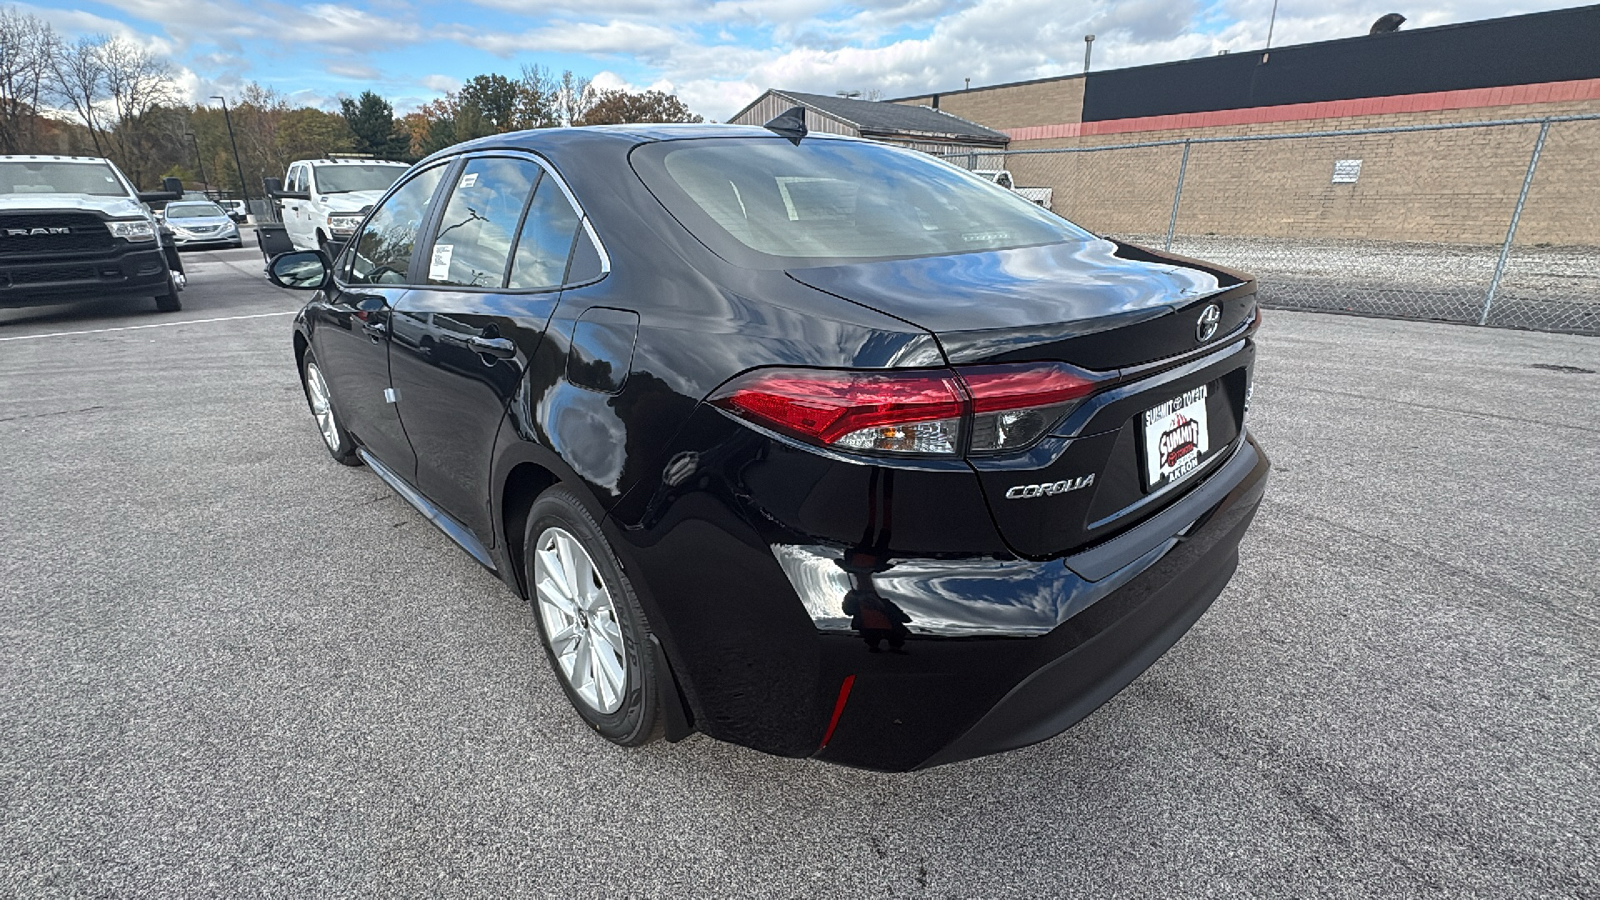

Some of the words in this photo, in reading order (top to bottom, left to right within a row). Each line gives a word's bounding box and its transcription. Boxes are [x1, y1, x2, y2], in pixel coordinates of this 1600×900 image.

[7, 227, 70, 236] RAM
[1145, 400, 1173, 425] SUMMIT
[1160, 421, 1198, 466] SUMMIT
[1168, 457, 1199, 483] AKRON
[1005, 472, 1096, 499] COROLLA
